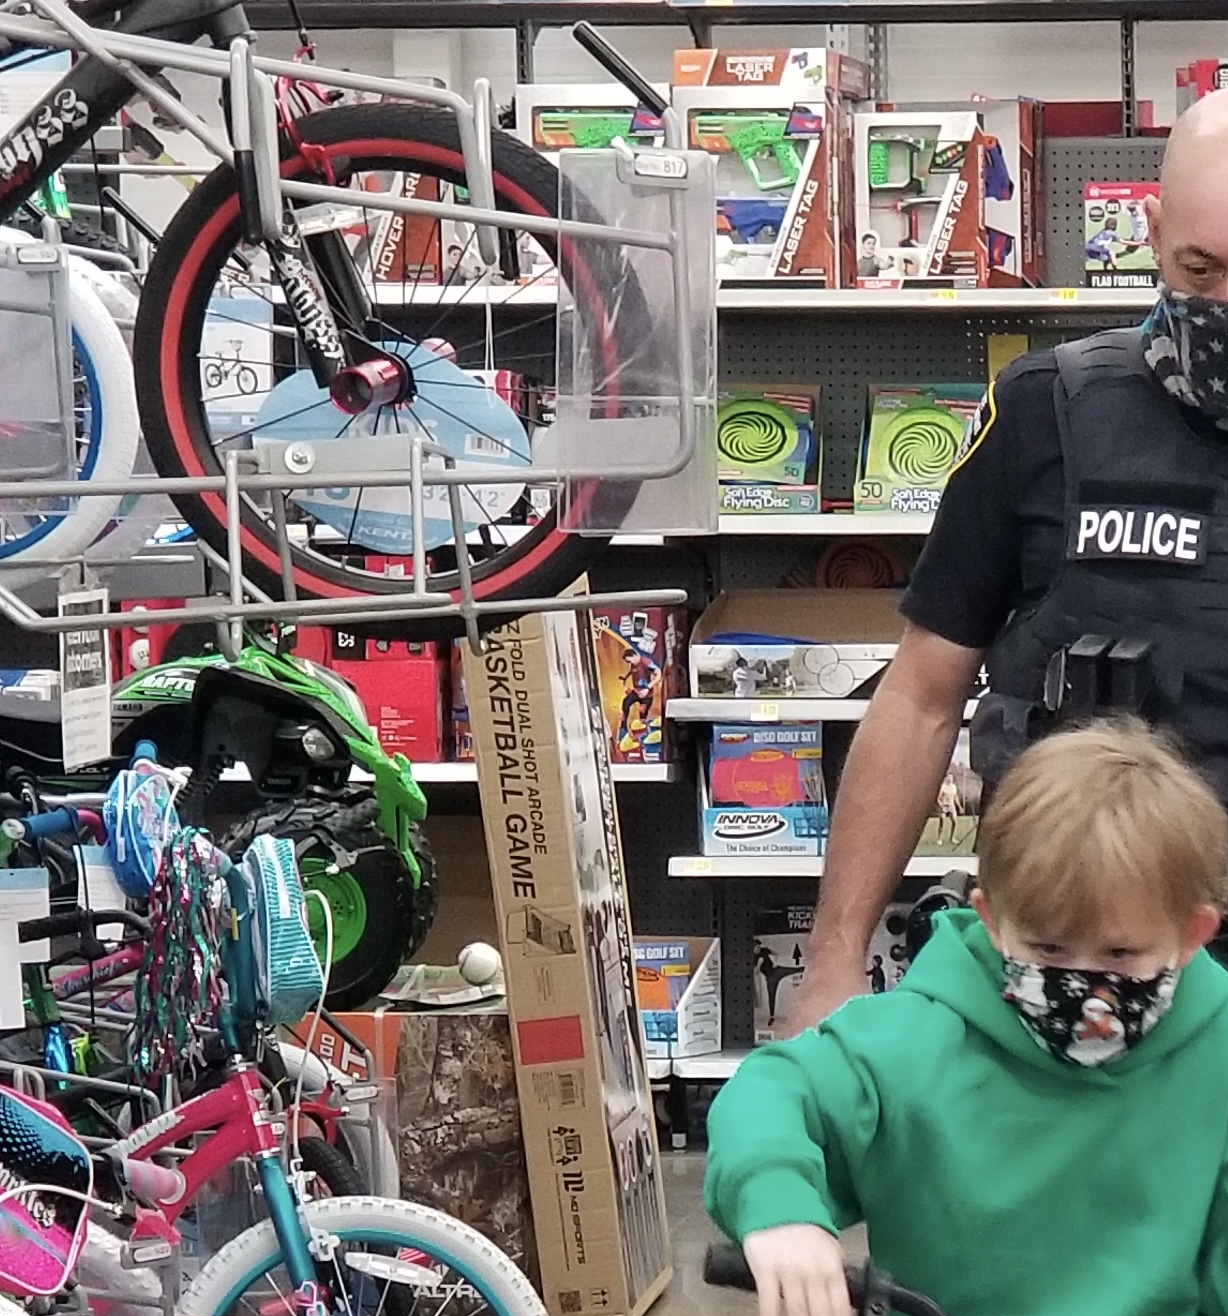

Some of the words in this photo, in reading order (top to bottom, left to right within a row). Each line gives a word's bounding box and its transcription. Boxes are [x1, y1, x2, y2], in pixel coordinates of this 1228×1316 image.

[663, 159, 684, 174] 817
[375, 215, 405, 281] HOVER
[778, 216, 806, 274] LASER
[799, 179, 819, 217] TAG
[930, 218, 957, 275] LASER
[950, 179, 969, 217] TAG
[723, 496, 763, 510] Flying
[763, 496, 790, 509] Disc
[860, 482, 883, 499] 50
[1076, 510, 1201, 560] POLICE
[511, 638, 526, 682] FOLD
[514, 690, 533, 735] DUAL
[520, 738, 540, 784] SHOT
[526, 787, 548, 856] ARCADE
[717, 814, 779, 825] INNOVA
[505, 813, 536, 900] GAME
